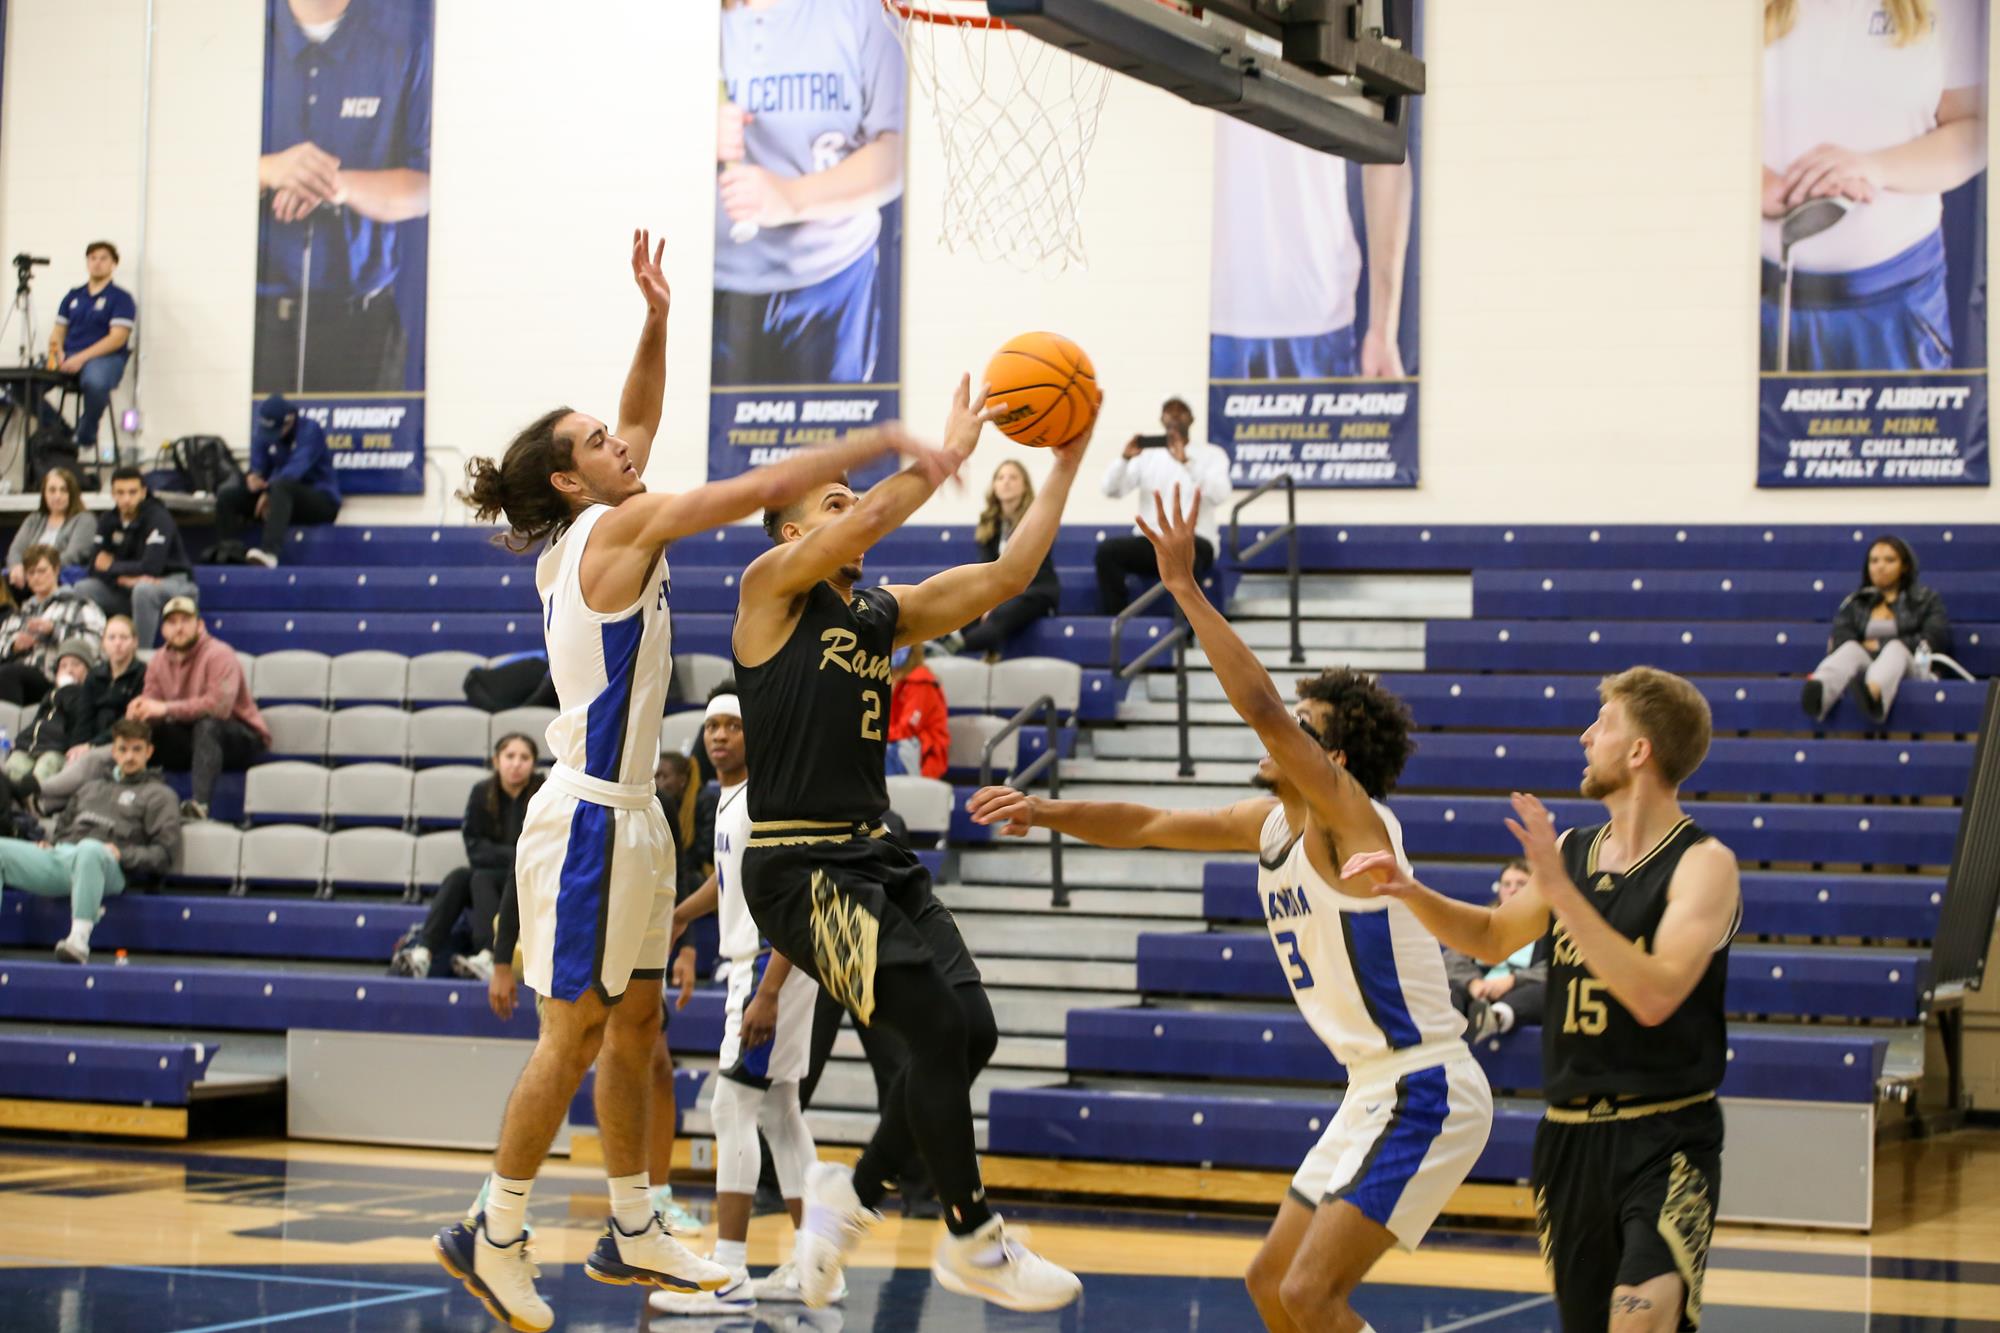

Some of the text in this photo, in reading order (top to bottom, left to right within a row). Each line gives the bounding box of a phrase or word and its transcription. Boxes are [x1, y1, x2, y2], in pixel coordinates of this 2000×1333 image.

[749, 72, 851, 113] CENTRAL
[1224, 393, 1408, 416] CULLEN FLEMING
[1781, 387, 1970, 411] ASHLEY ABBOTT
[734, 401, 796, 423] EMMA
[332, 452, 414, 469] EADERSHIP
[1320, 462, 1397, 480] STUDIES
[1803, 459, 1878, 478] FAMILY
[1882, 458, 1966, 477] STUDIES
[819, 627, 893, 686] Ram
[861, 689, 882, 741] 2
[1275, 930, 1315, 990] 3
[1562, 976, 1608, 1036] 15
